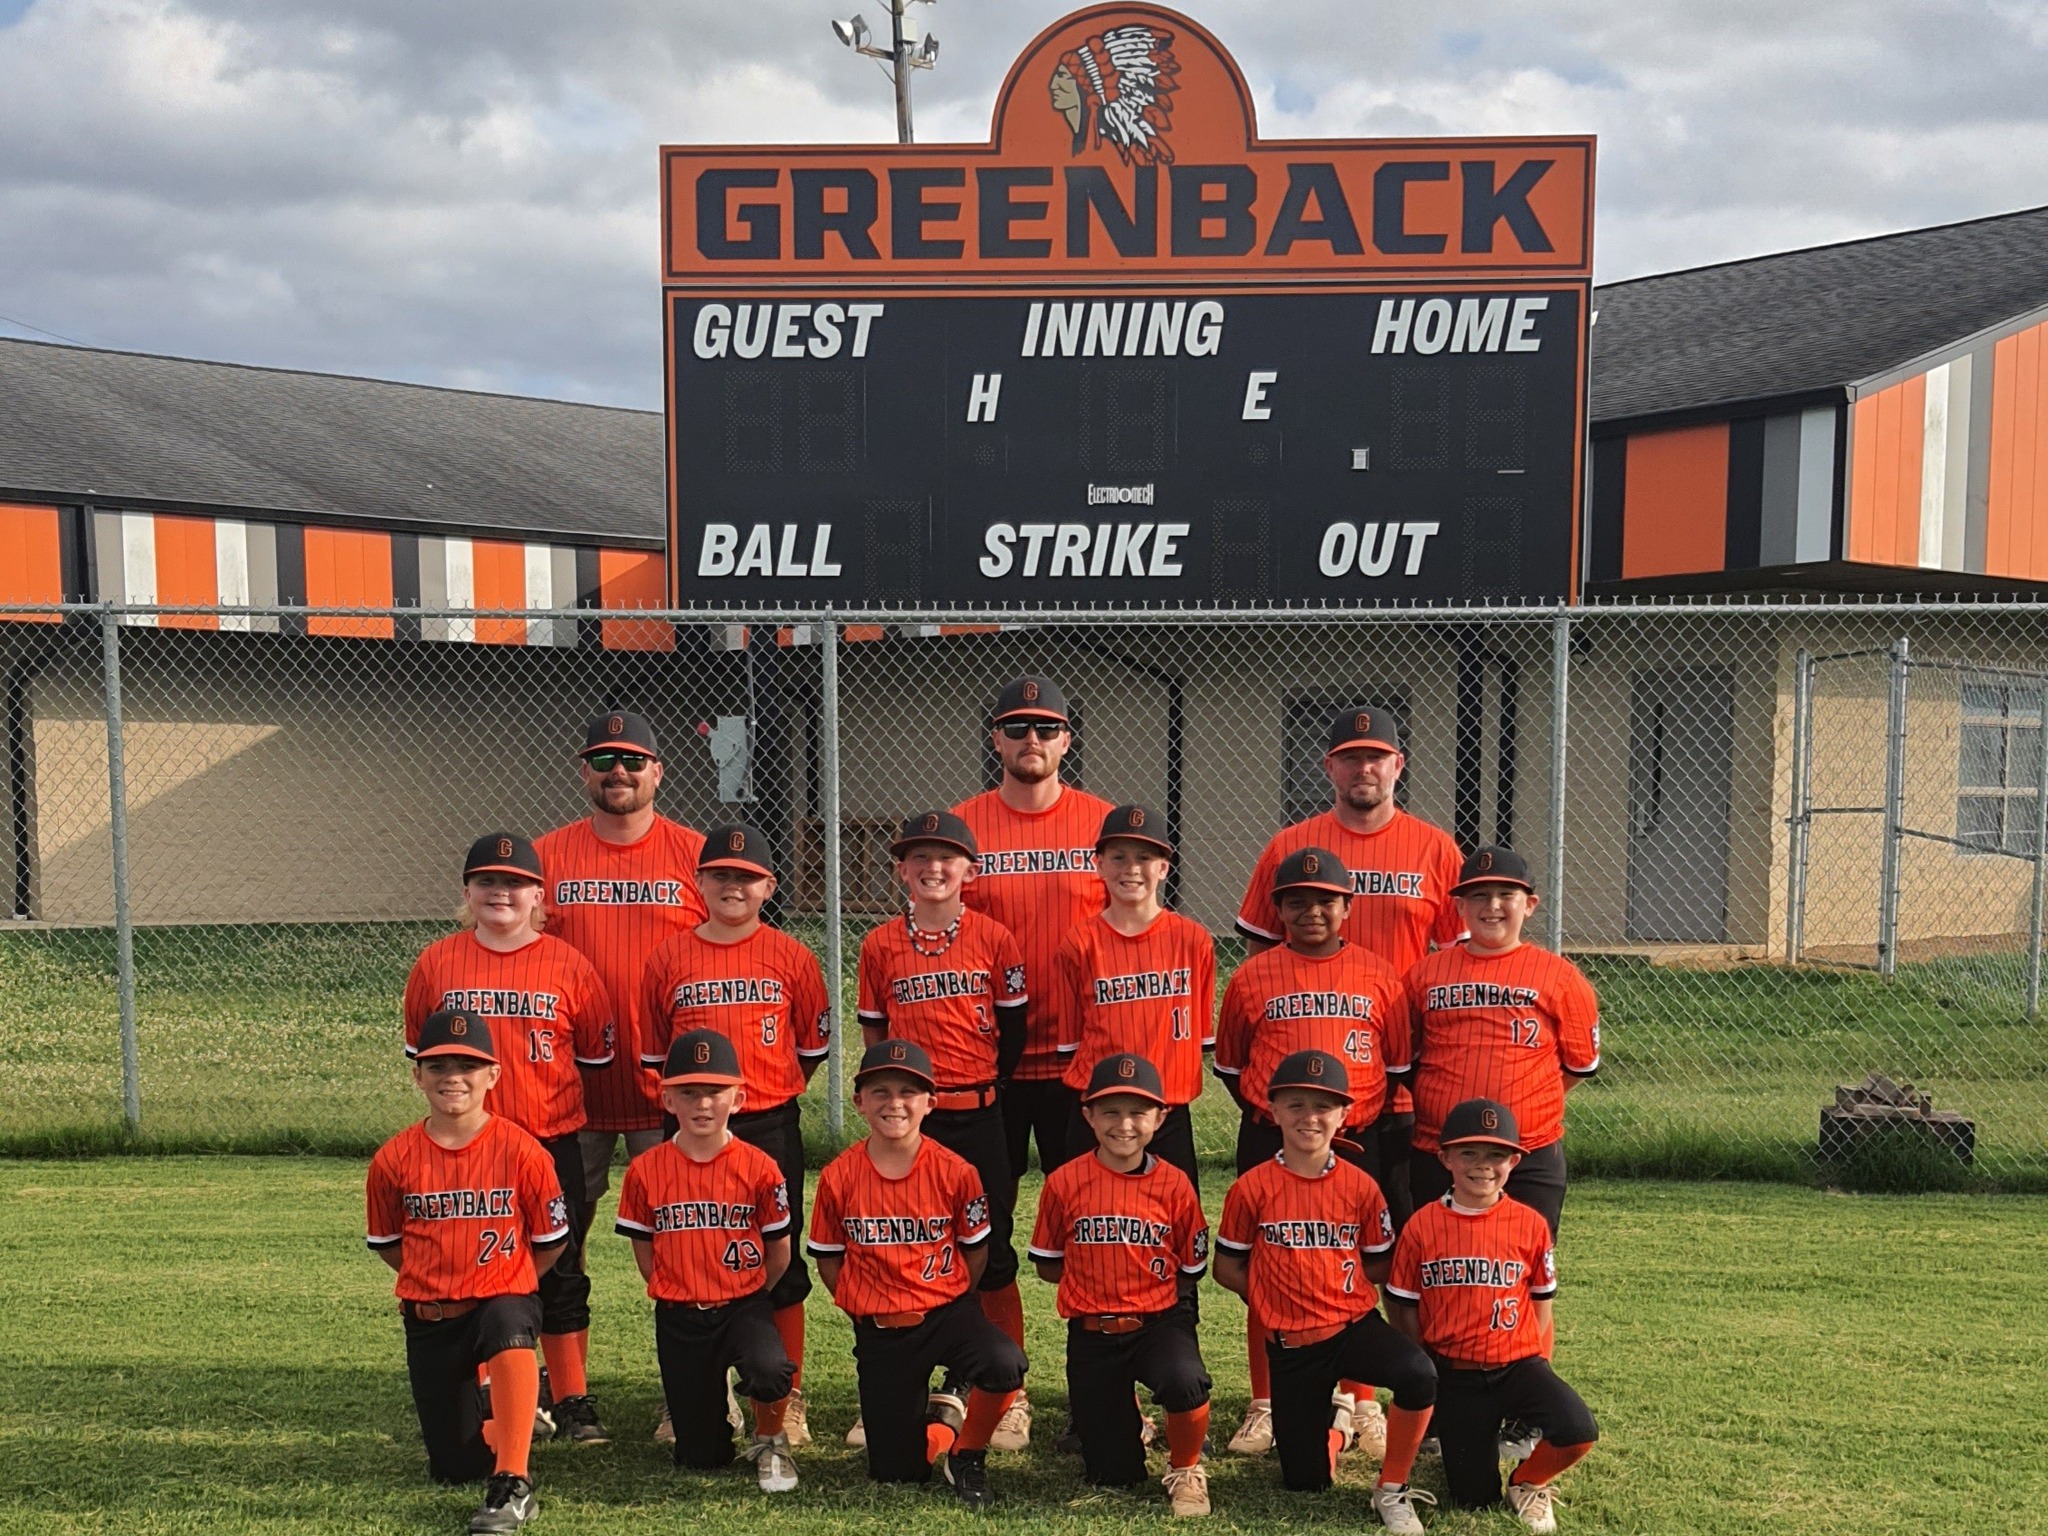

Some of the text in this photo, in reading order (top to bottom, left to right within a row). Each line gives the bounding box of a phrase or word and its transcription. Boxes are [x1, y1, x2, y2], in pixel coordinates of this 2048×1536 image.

[695, 159, 1557, 261] GREENBACK
[692, 302, 885, 359] GUEST
[1020, 300, 1225, 358] INNING
[1370, 296, 1549, 355] HOME
[965, 373, 1002, 423] H
[1241, 370, 1278, 421] E
[697, 523, 843, 577] BALL
[978, 522, 1190, 578] STRIKE
[1317, 521, 1440, 578] OUT
[1023, 681, 1038, 700] G
[608, 716, 624, 735] G
[1355, 713, 1371, 733] G
[923, 814, 939, 832] G
[1129, 808, 1145, 827] G
[497, 838, 513, 858] G
[729, 831, 745, 851] G
[1303, 854, 1319, 874] G
[1477, 852, 1493, 871] G
[556, 881, 683, 905] GREENBACK
[675, 978, 783, 1009] GREENBACK
[892, 970, 991, 1004] GREENBACK
[1094, 968, 1191, 1005] REENBACK
[1427, 983, 1538, 1010] GREENBACK
[443, 989, 560, 1020] GREENBACK
[1265, 992, 1373, 1022] GREENBACK
[451, 1016, 467, 1036] G
[762, 1014, 777, 1046] 8
[1171, 1006, 1191, 1040] 11
[1511, 1018, 1540, 1048] 12
[529, 1029, 555, 1062] 16
[694, 1042, 710, 1064] G
[890, 1044, 906, 1060] G
[1343, 1029, 1372, 1062] 45
[1119, 1058, 1135, 1078] G
[1307, 1057, 1324, 1076] G
[1482, 1108, 1498, 1129] G
[653, 1201, 756, 1233] GREENBACK
[843, 1215, 952, 1245] GREENBACK
[478, 1227, 517, 1265] 24
[722, 1239, 763, 1272] 49
[1342, 1260, 1355, 1293] 7
[1421, 1257, 1524, 1289] GREENBACK
[1489, 1298, 1518, 1331] 13
